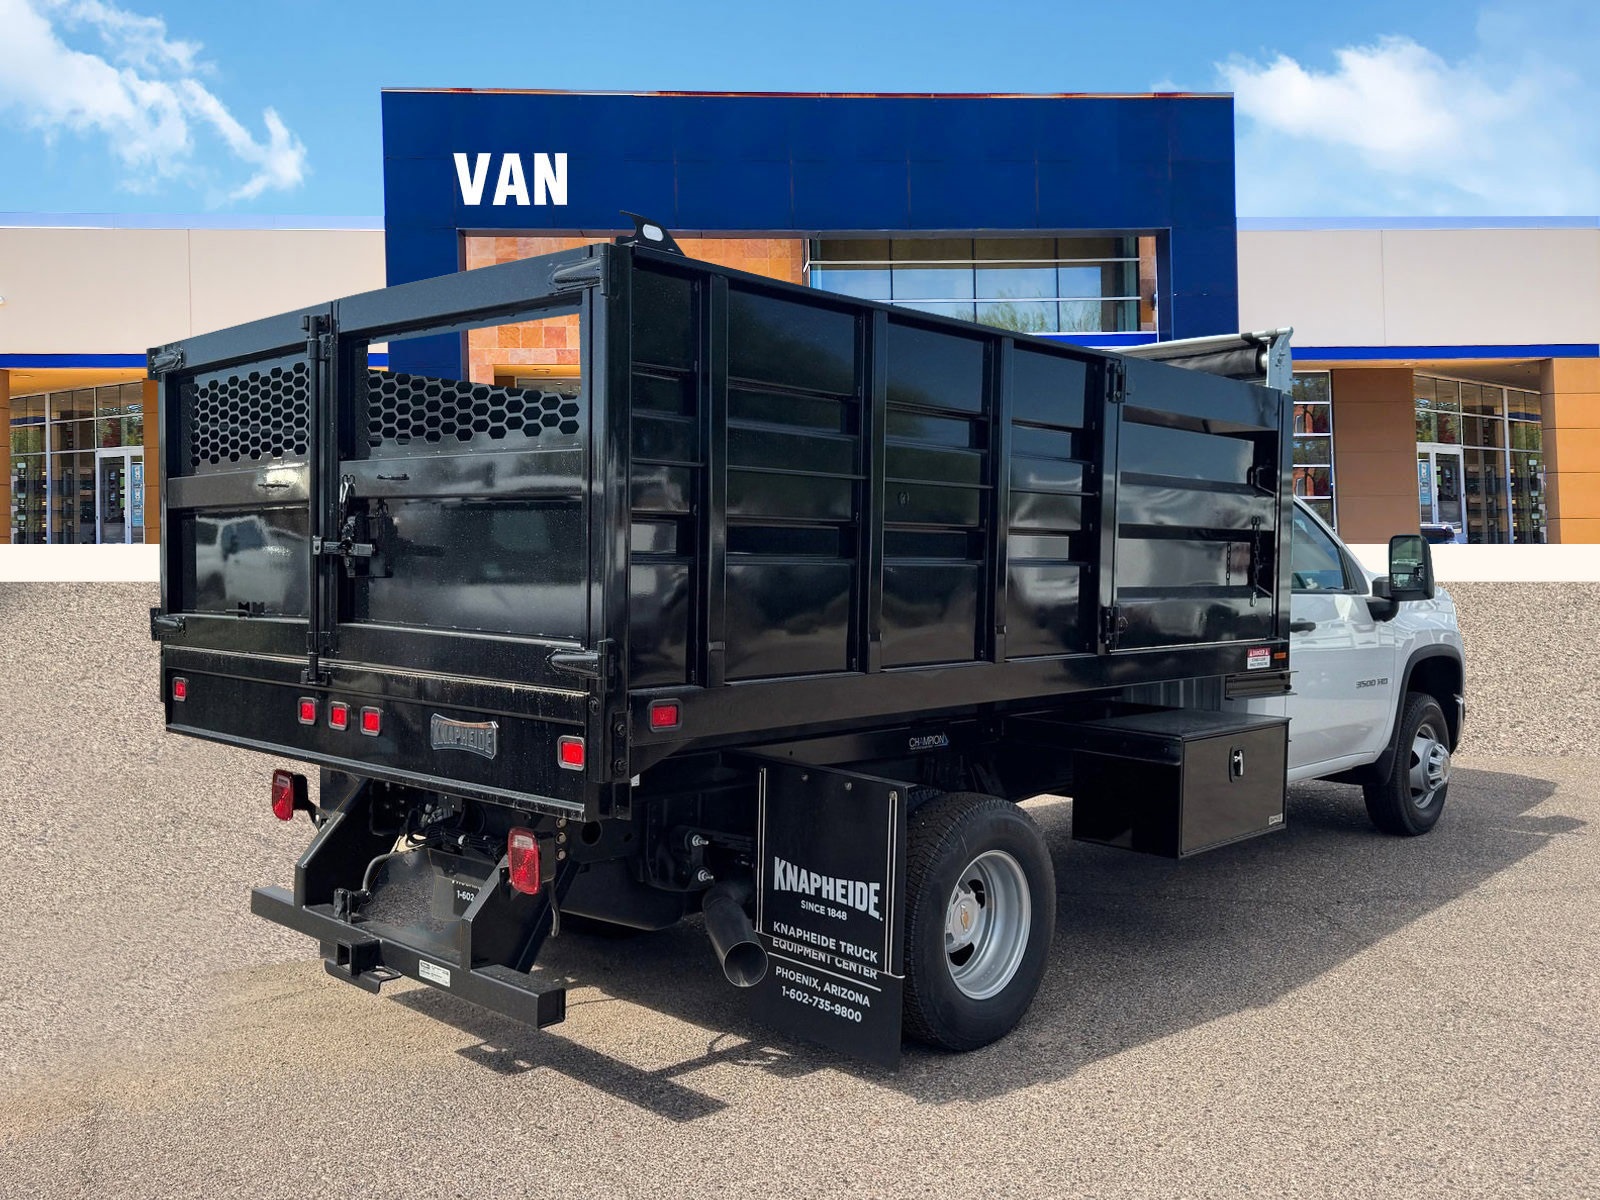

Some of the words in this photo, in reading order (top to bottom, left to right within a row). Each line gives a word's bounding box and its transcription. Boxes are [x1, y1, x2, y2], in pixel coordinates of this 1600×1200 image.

[453, 152, 568, 206] VAN
[456, 889, 475, 902] 1-602
[800, 900, 826, 915] SINCE
[827, 907, 848, 921] 1848
[772, 937, 831, 964] EQUIPMENT
[834, 956, 878, 980] CENTER
[773, 921, 836, 950] KNAPHEIDE
[839, 940, 878, 964] TRUCK
[775, 965, 822, 992] PHOENIX,
[823, 982, 871, 1008] ARIZONA
[781, 985, 862, 1023] 1-602-735-9800
